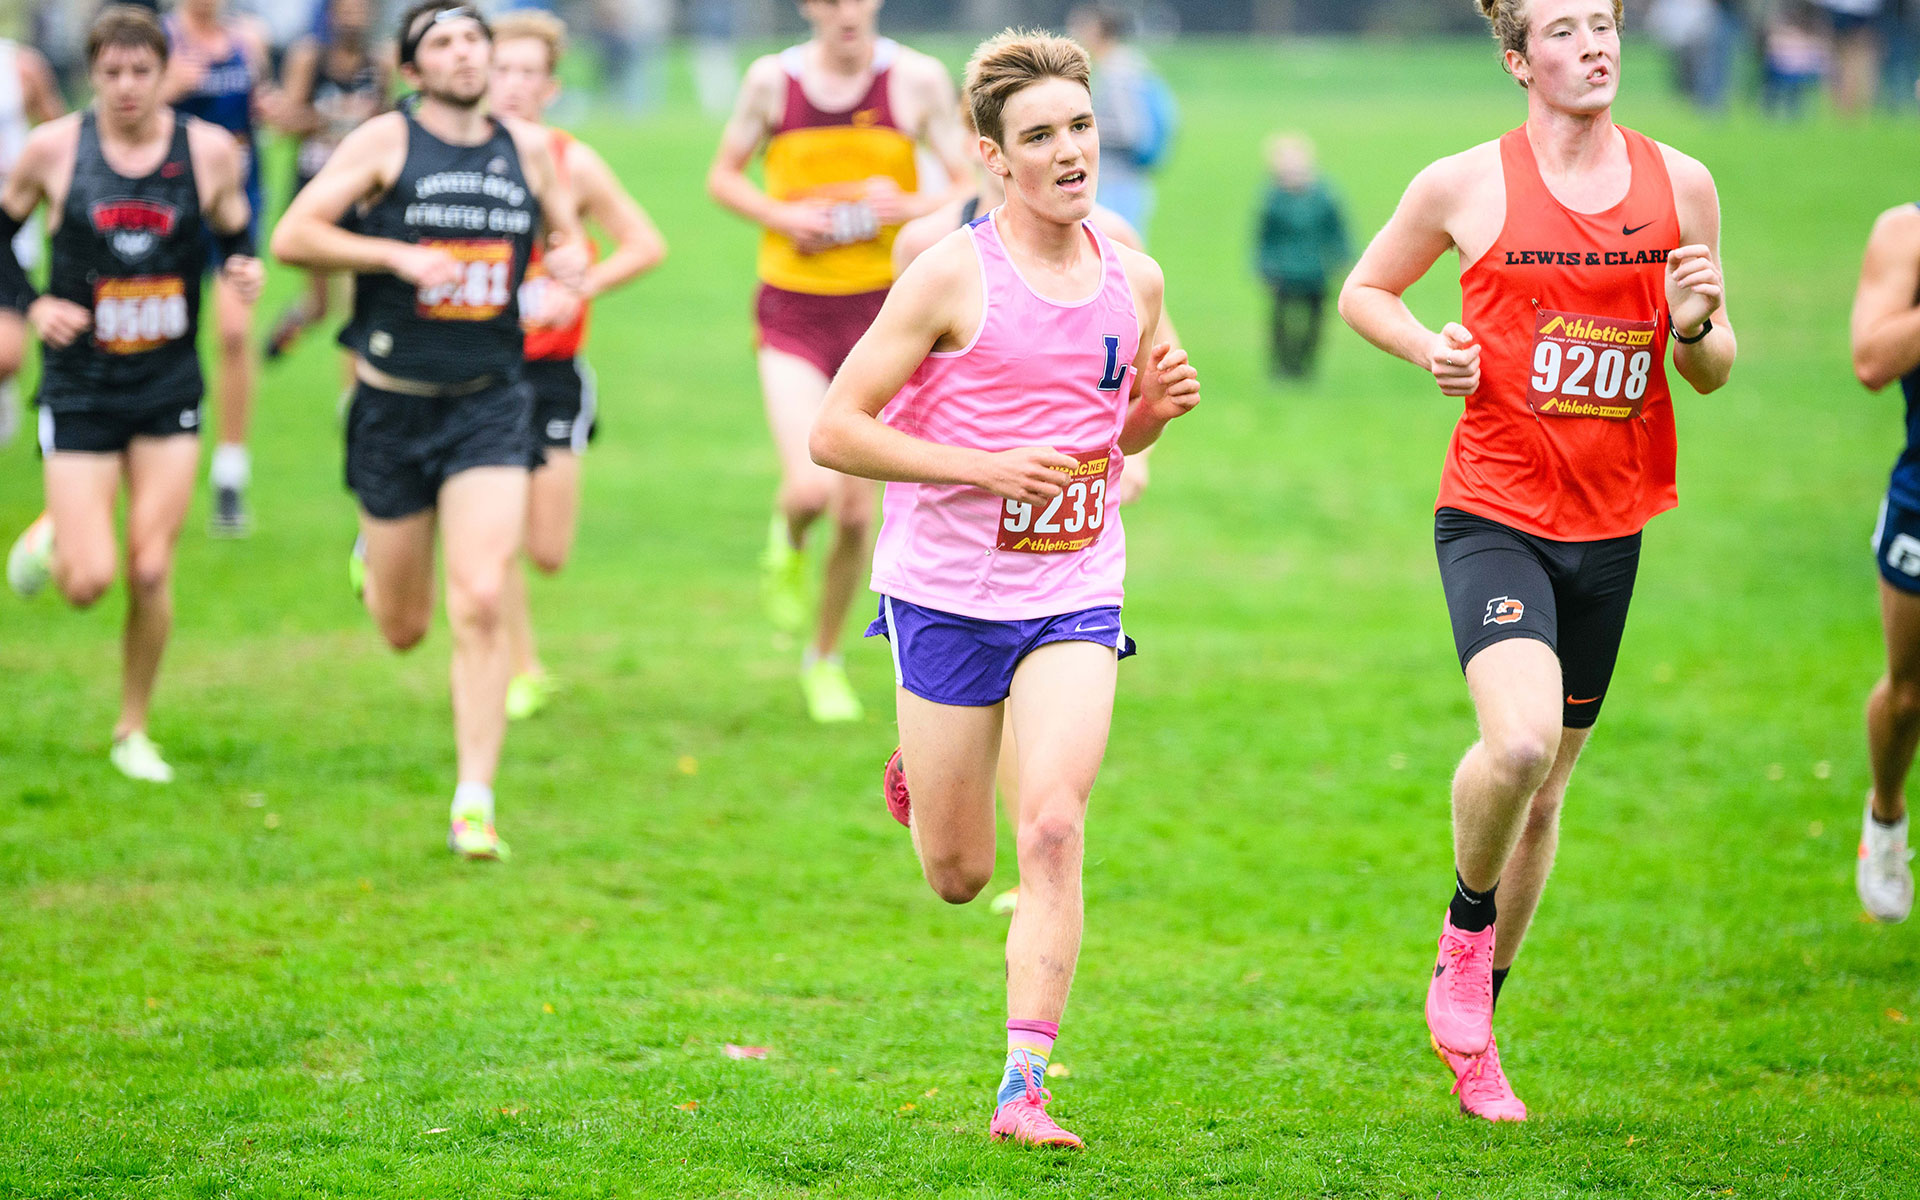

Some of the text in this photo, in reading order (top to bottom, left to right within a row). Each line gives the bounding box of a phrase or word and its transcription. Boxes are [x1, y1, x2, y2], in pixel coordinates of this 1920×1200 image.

[1505, 250, 1581, 266] LEWIS
[1585, 252, 1600, 266] &
[1538, 315, 1652, 344] Athletic NET
[1097, 334, 1128, 391] L
[1531, 340, 1651, 400] 9208
[1540, 397, 1629, 416] Athletic TIMING
[1089, 461, 1106, 473] NET
[1012, 537, 1070, 552] Athletic
